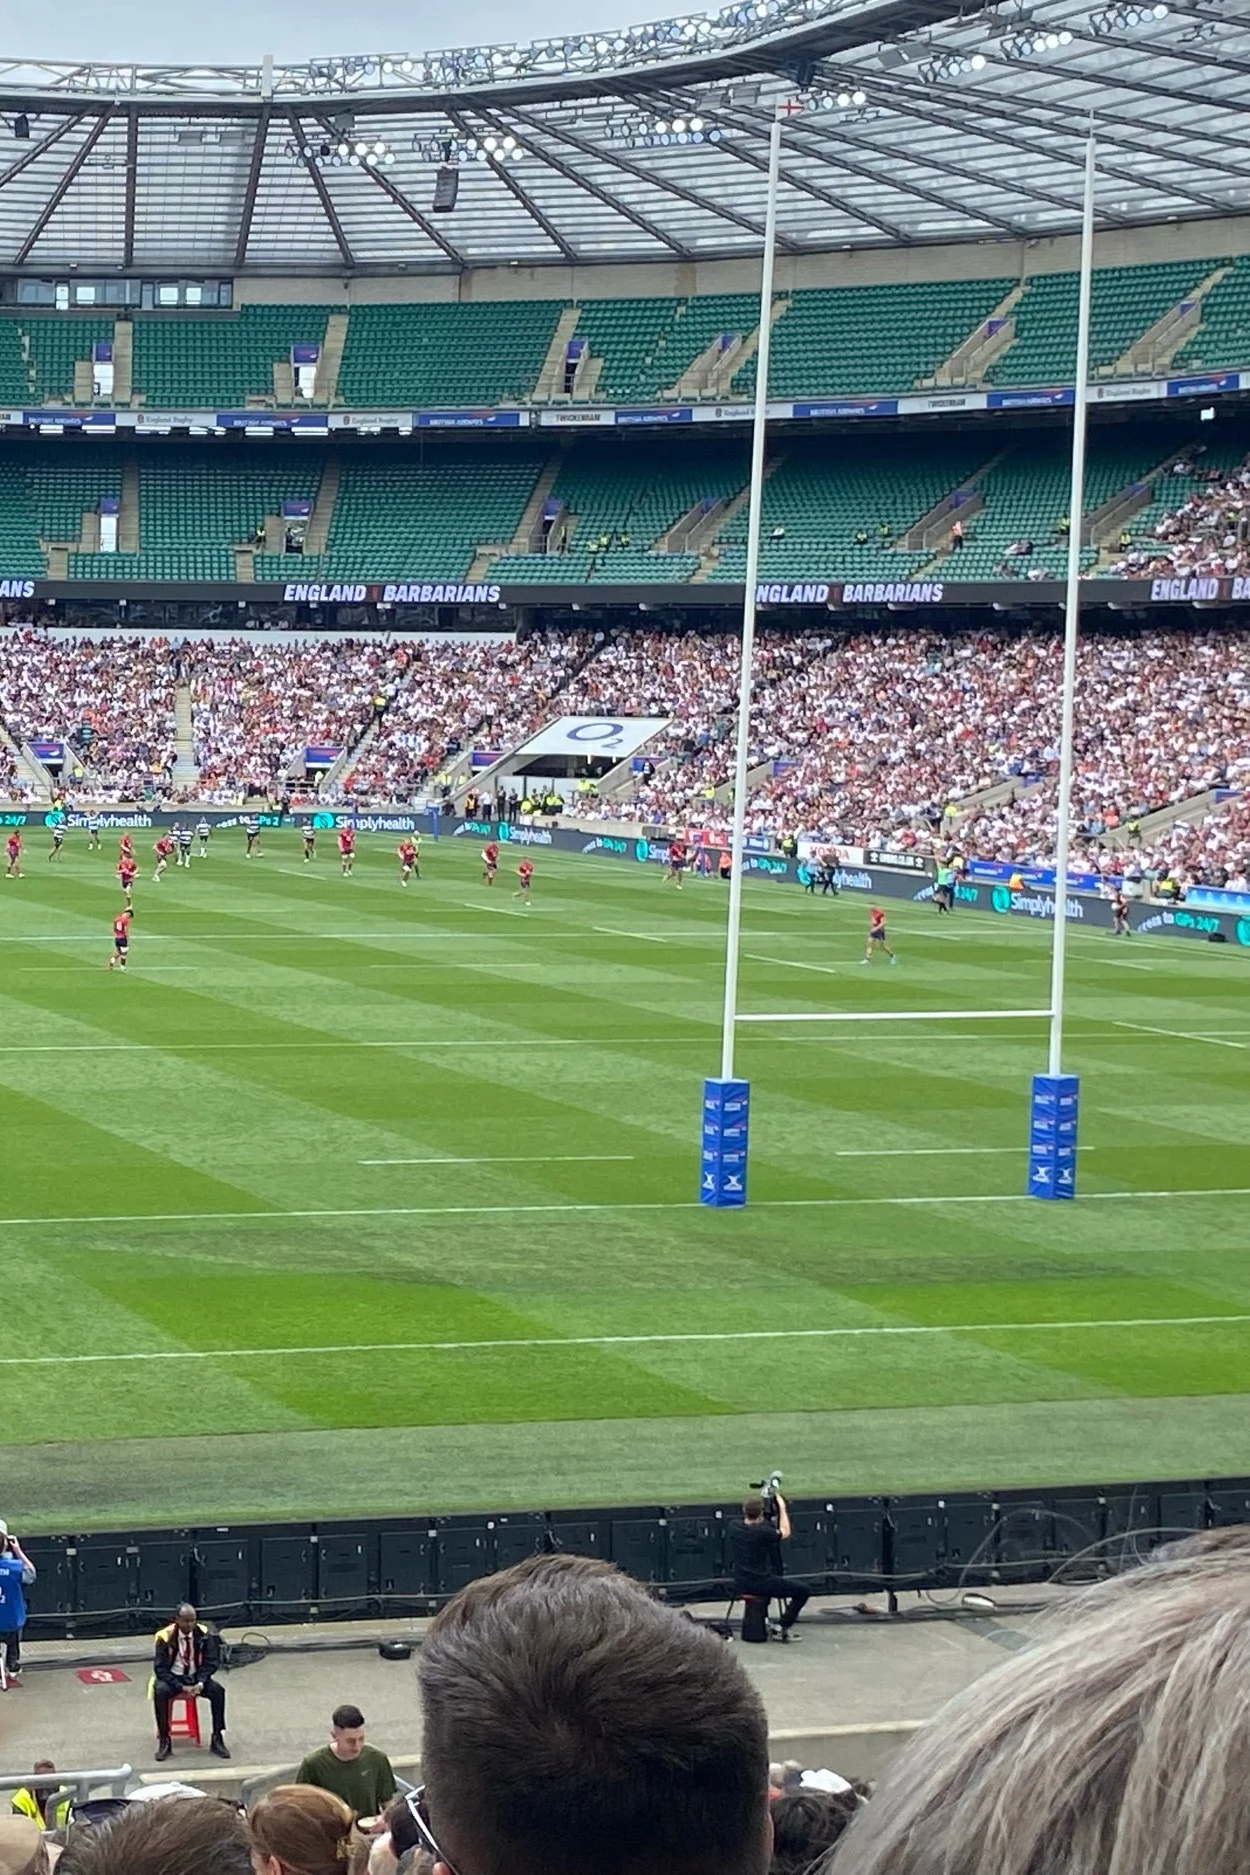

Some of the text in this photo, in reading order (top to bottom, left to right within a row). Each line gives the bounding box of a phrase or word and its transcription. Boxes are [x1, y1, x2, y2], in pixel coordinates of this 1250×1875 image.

[284, 584, 501, 602] ENGLAND BARBARIANS
[754, 583, 944, 603] NGLAND BARBARIANS
[1151, 578, 1219, 601] ENGLAND
[4, 815, 26, 827] 24/7
